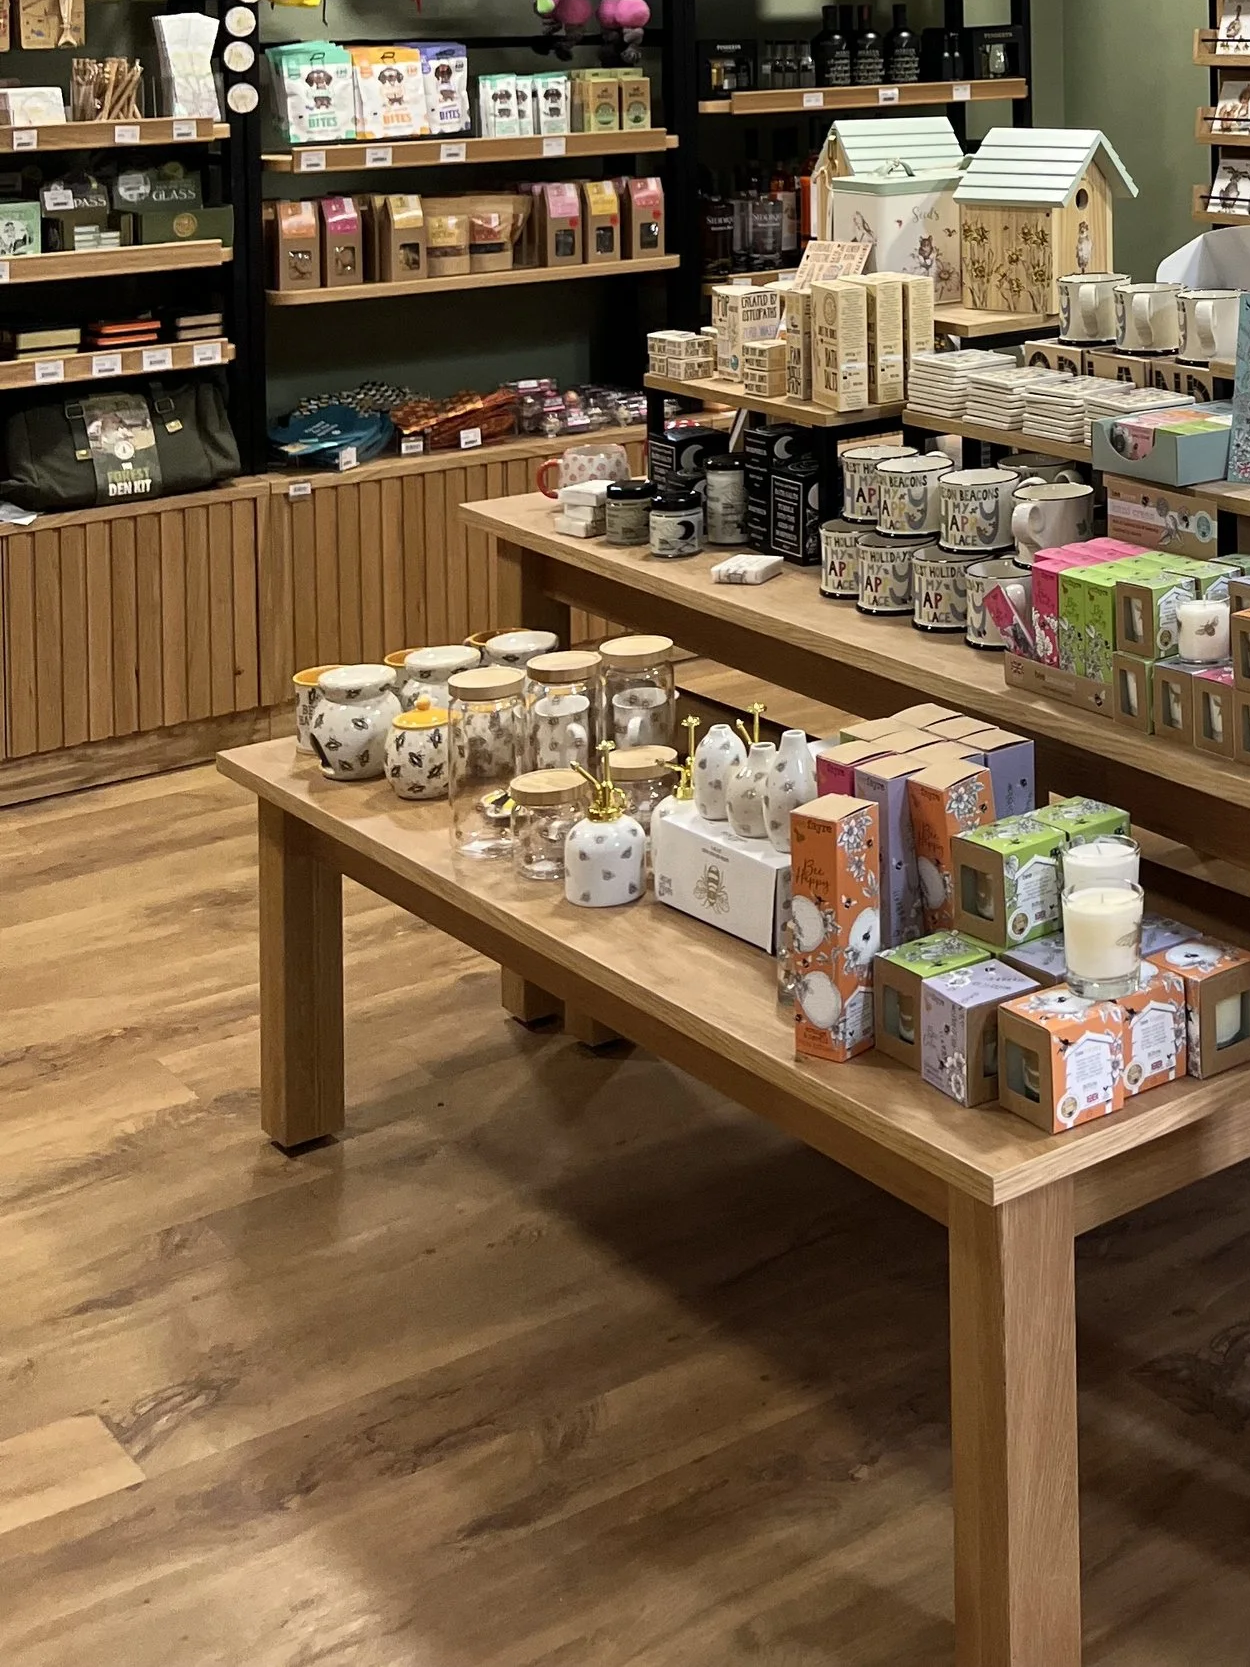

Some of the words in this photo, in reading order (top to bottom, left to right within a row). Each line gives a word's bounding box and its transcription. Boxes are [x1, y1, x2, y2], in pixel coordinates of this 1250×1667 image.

[383, 112, 412, 124] BITES
[439, 109, 460, 120] BITES
[309, 116, 338, 128] BITES
[152, 189, 196, 202] GLASS
[74, 197, 107, 208] PASS
[108, 481, 132, 496] DEN
[134, 479, 152, 494] KIT
[889, 475, 928, 488] BEACONS
[959, 487, 999, 502] BEACONS
[952, 501, 969, 515] MY
[929, 565, 968, 579] HOLIDA
[803, 860, 825, 876] Bee
